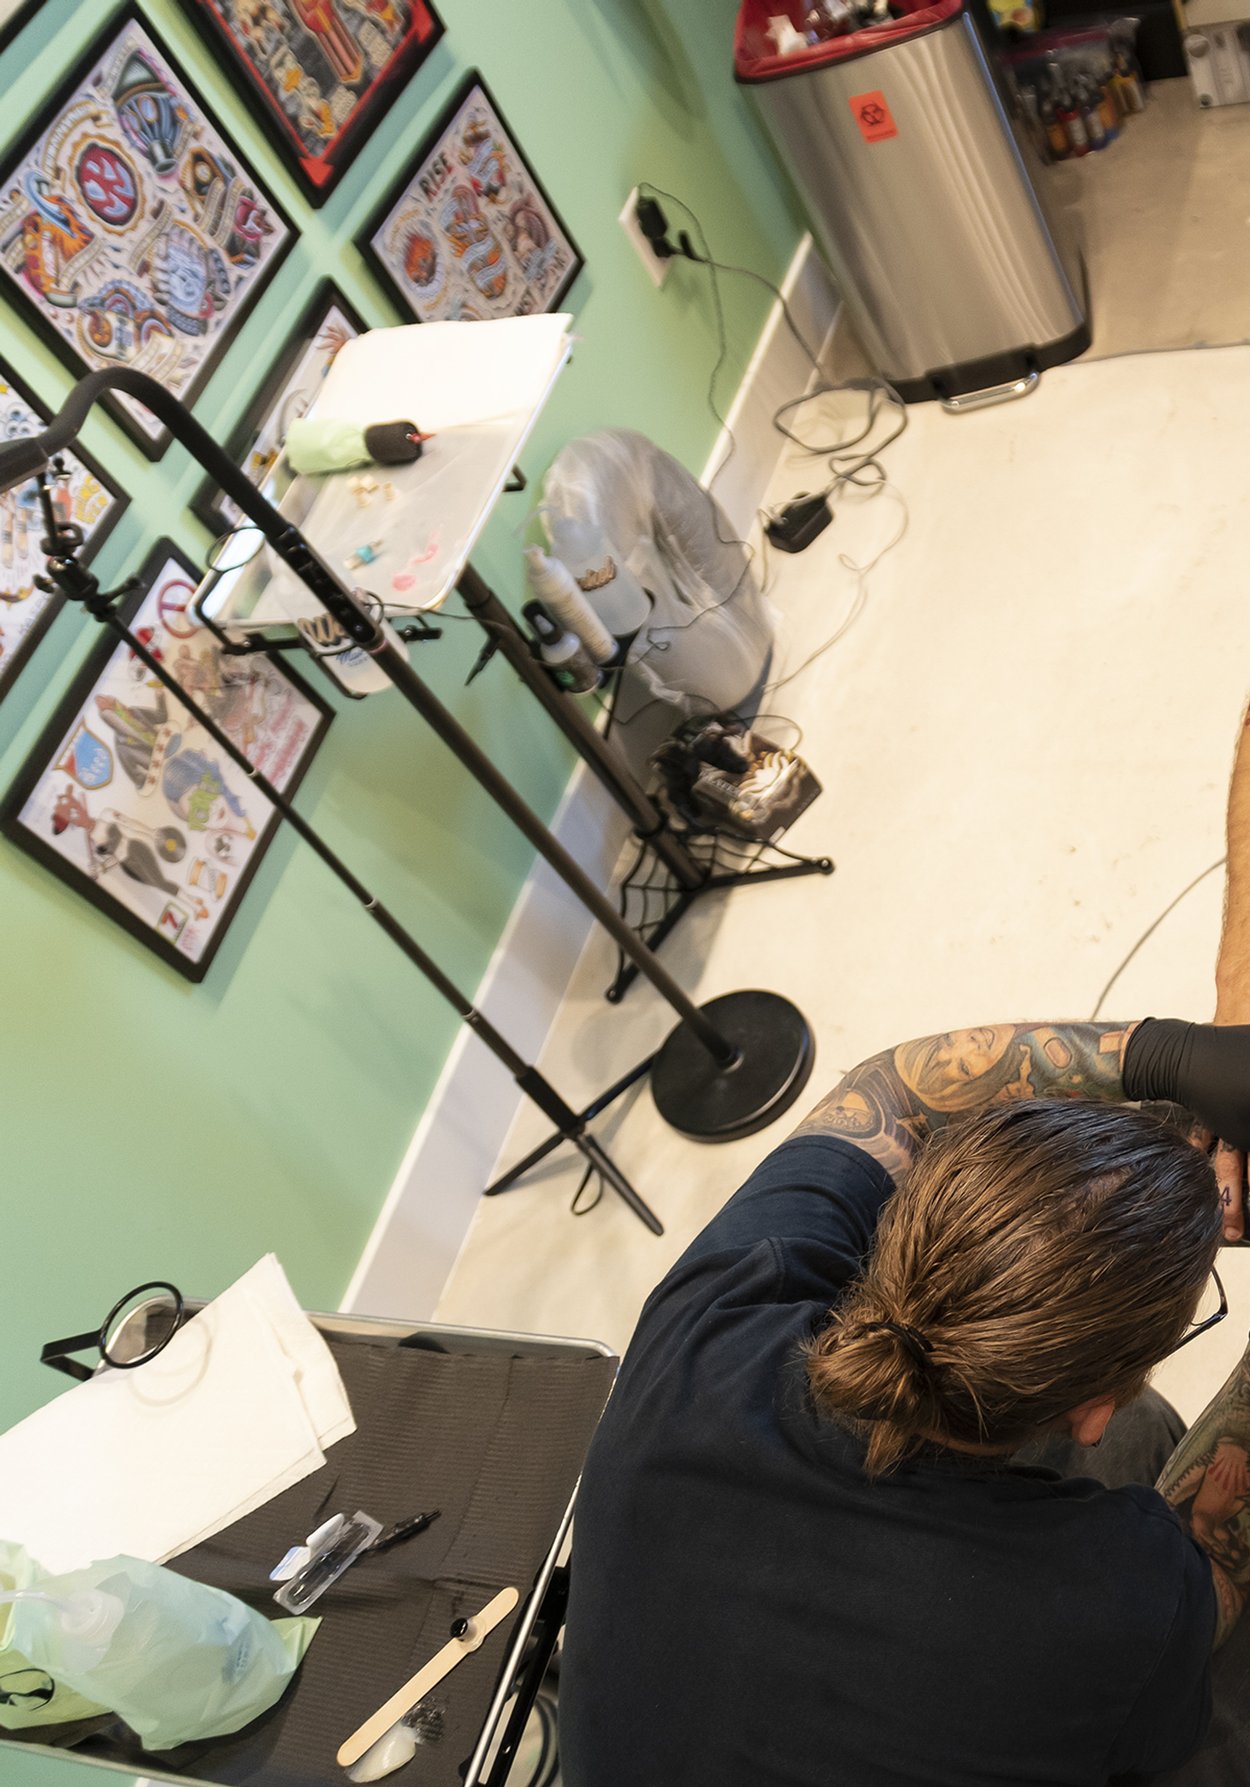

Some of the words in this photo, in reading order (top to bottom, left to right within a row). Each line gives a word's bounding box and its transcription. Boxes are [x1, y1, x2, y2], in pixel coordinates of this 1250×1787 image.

[419, 152, 453, 203] RISE
[161, 911, 178, 929] 7
[1220, 1186, 1232, 1207] 4
